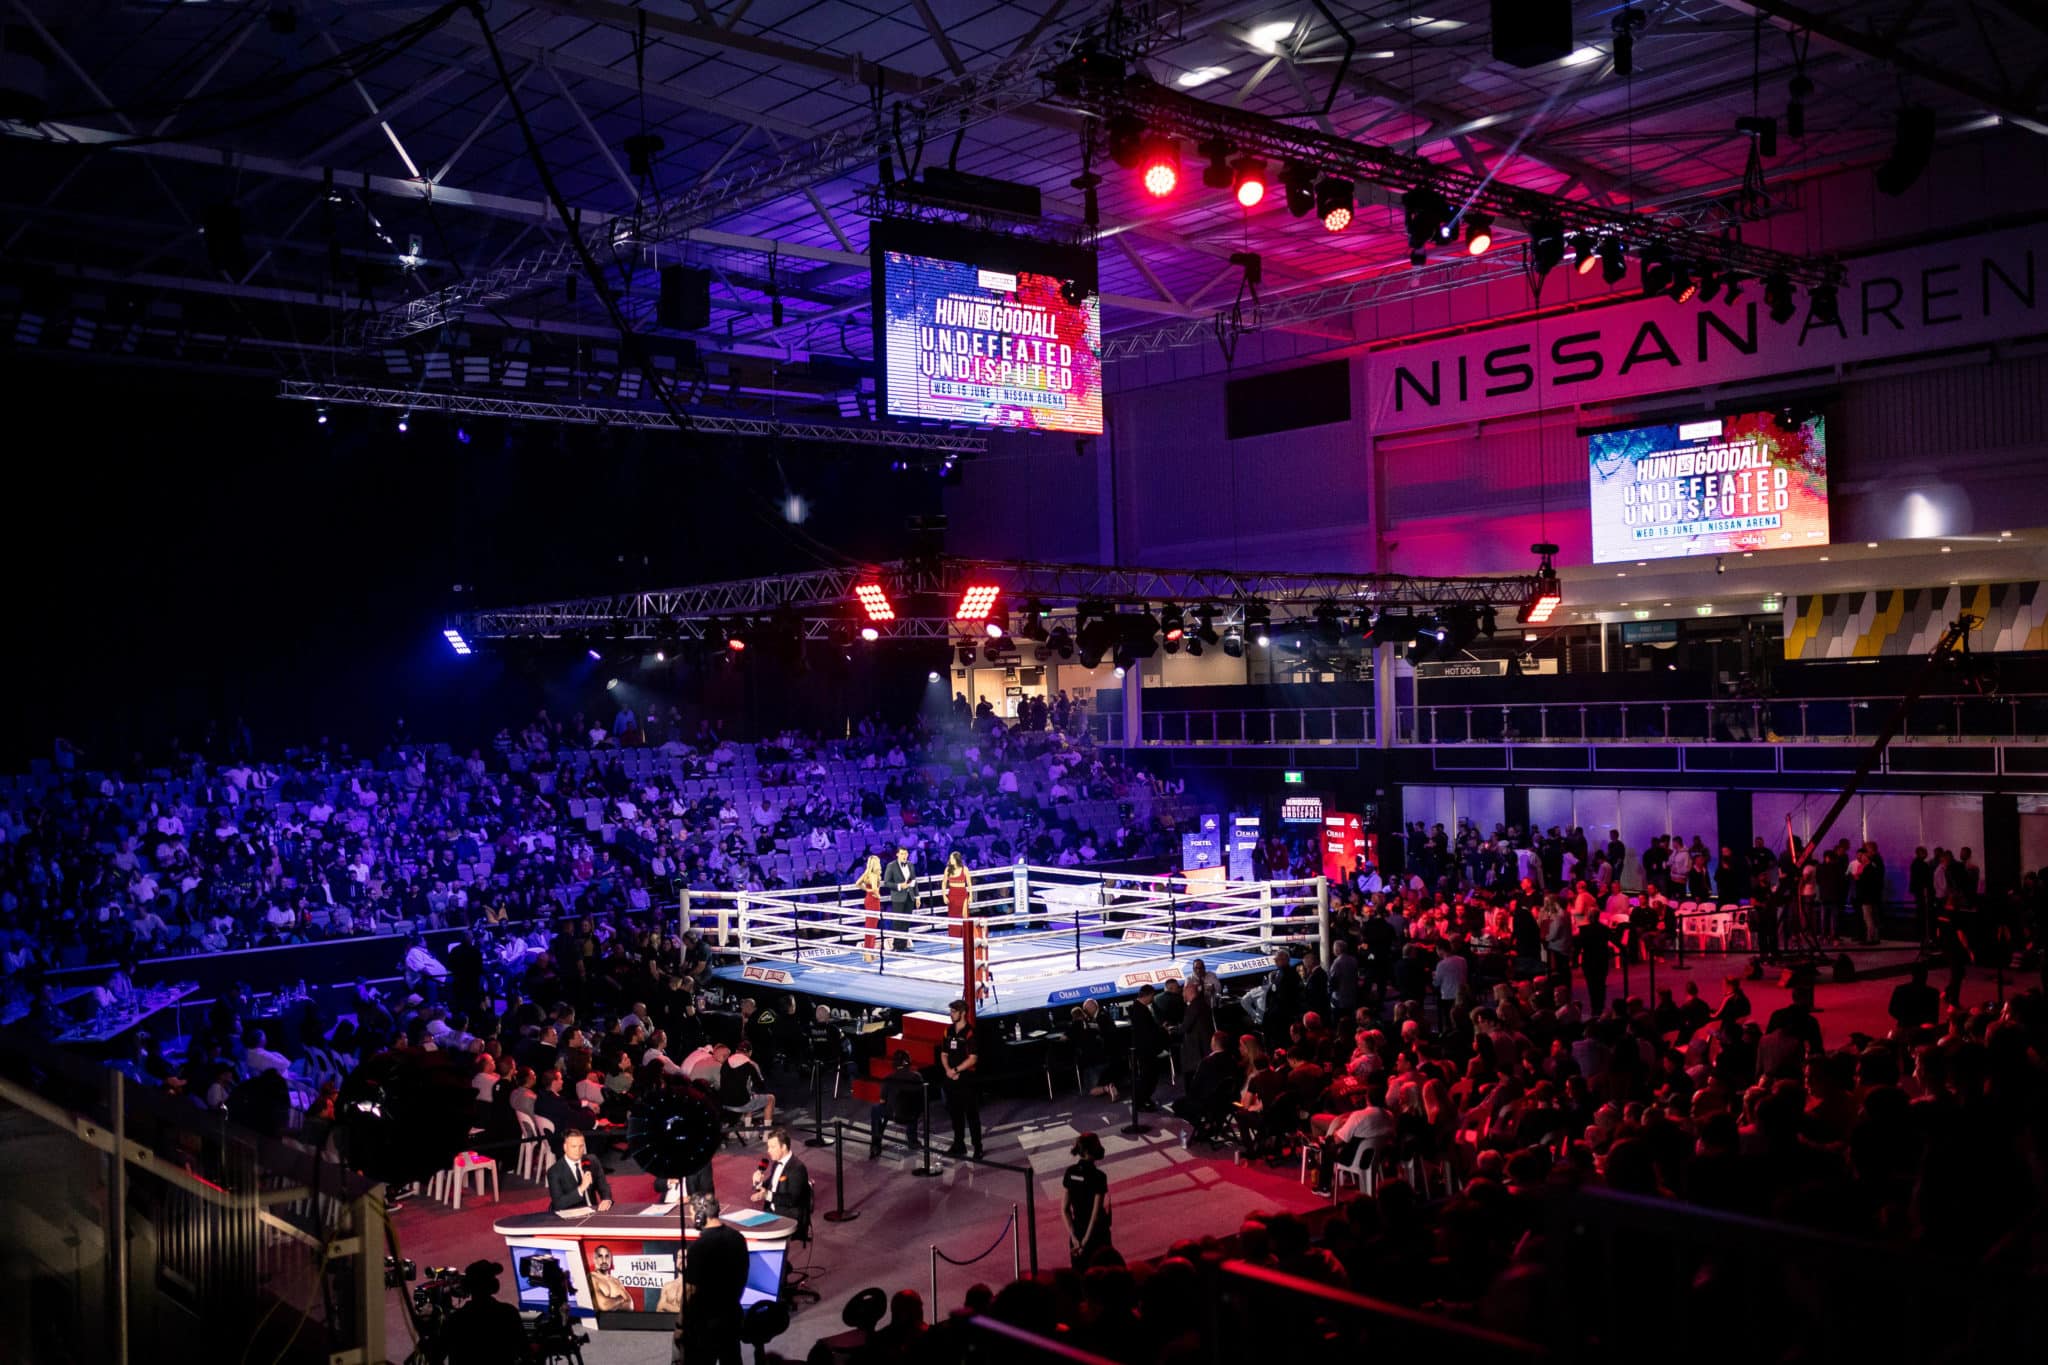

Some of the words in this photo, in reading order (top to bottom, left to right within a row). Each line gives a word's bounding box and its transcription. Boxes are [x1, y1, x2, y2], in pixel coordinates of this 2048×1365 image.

[935, 298, 974, 328] HUNI
[992, 306, 1058, 339] GOODALL
[921, 326, 1072, 367] UNDEFEATED
[1395, 302, 1757, 412] NISSAN
[922, 350, 1073, 390] UNDISPUTED
[934, 382, 952, 394] WED
[957, 384, 967, 396] 15
[970, 387, 991, 398] JUNE
[1003, 389, 1034, 402] NISSAN
[1036, 393, 1064, 405] ARENA
[1636, 455, 1677, 482] HUNI
[1694, 444, 1772, 475] GOODALL
[1624, 468, 1789, 506] UNDEFEATED
[1624, 489, 1789, 525] UNDISPUTED
[1635, 527, 1654, 538] WED
[1659, 526, 1669, 536] 15
[1671, 524, 1694, 535] JUNE
[1707, 519, 1742, 531] NISSAN
[1745, 515, 1778, 527] ARENA
[1444, 667, 1460, 676] HOT
[1460, 666, 1481, 675] DOGS
[1228, 957, 1271, 971] PALMERBET
[617, 1275, 665, 1288] GOODALL
[630, 1260, 657, 1272] HUNI
